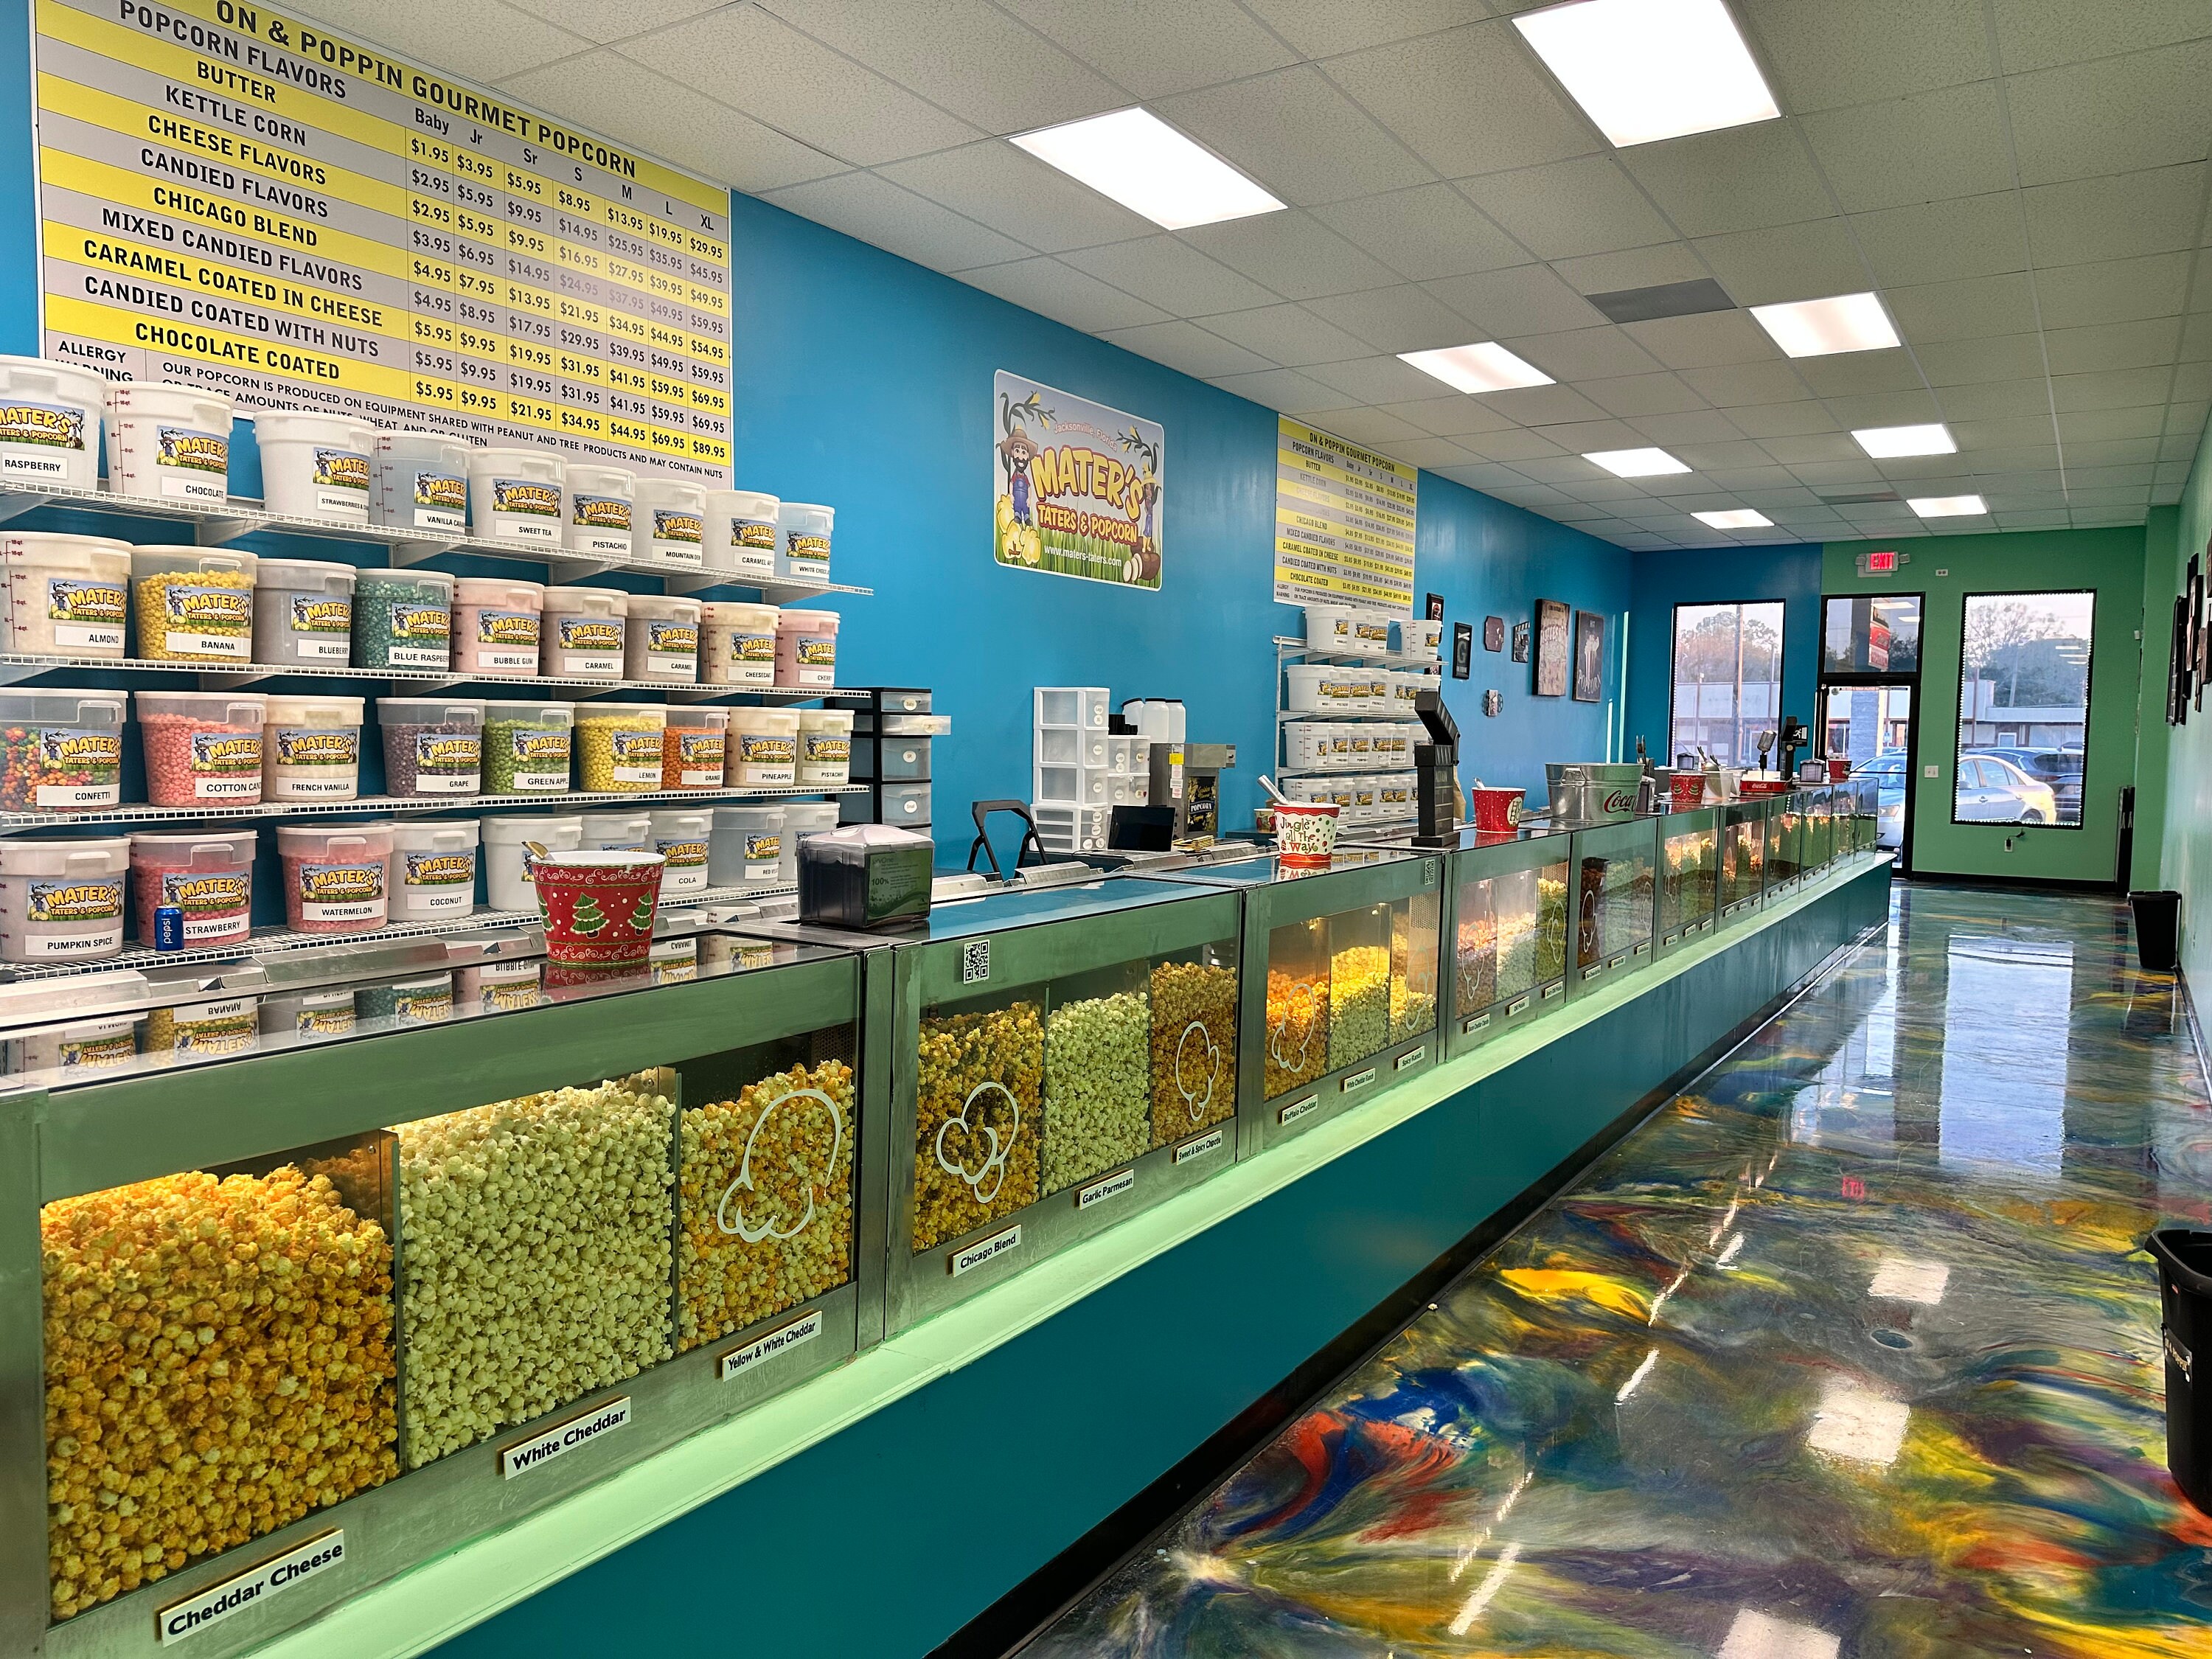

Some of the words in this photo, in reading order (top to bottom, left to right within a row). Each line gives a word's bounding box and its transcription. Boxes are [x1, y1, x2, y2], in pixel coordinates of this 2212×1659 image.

[121, 0, 237, 60] POPCORN
[248, 46, 345, 98] FLAVORS
[198, 60, 276, 103] BUTTER
[218, 0, 256, 33] ON
[268, 21, 289, 46] &
[302, 31, 402, 88] POPPIN
[413, 76, 530, 136] GOURMET
[539, 124, 635, 178] POPCORN
[167, 85, 246, 127] KETTLE
[254, 115, 305, 146] CORN
[149, 116, 233, 156] CHEESE
[240, 143, 325, 184] FLAVORS
[416, 108, 449, 135] Baby
[470, 129, 482, 145] Jr
[524, 148, 538, 164] Sr
[575, 167, 582, 181] S
[622, 184, 631, 200] M
[666, 201, 672, 215] L
[701, 215, 714, 231] XL
[142, 149, 234, 189] CANDIED
[243, 178, 327, 218] FLAVORS
[411, 138, 448, 162] $1.95
[458, 154, 493, 178] $3.95
[508, 172, 540, 195] $5.95
[559, 189, 590, 211] $8.95
[608, 207, 642, 230] $13.95
[650, 222, 681, 244] $19.95
[691, 237, 722, 258] $29.95
[154, 187, 246, 226] CHICAGO
[254, 215, 316, 246] BLEND
[103, 208, 173, 241] MIXED
[183, 230, 271, 266] CANDIED
[280, 254, 361, 290] FLAVORS
[85, 240, 191, 281] CARAMEL
[199, 268, 276, 300] COATED
[283, 288, 303, 307] IN
[311, 296, 382, 327] CHEESE
[86, 276, 182, 313] CANDIED
[192, 301, 268, 332] COATED
[275, 319, 324, 345] WITH
[333, 333, 378, 356] NUTS
[58, 341, 126, 363] ALLERGY
[136, 323, 259, 364] CHOCOLATE
[267, 351, 338, 379] COATED
[163, 362, 192, 376] OUR
[197, 369, 260, 389] POPCORN
[264, 381, 273, 392] IS
[278, 384, 340, 403] PRODUCED
[344, 397, 361, 408] ON
[366, 401, 425, 420] EQUIPMENT
[429, 414, 467, 428] SHARED
[471, 422, 494, 434] WITH
[498, 427, 534, 441] PEANUT
[537, 435, 556, 445] AND
[560, 439, 579, 450] TREE
[584, 444, 626, 459] PRODUCTS
[629, 453, 647, 463] AND
[650, 457, 666, 467] MAY
[669, 461, 702, 474] CONTAIN
[705, 468, 722, 479] NUTS
[417, 380, 453, 401] $5.95
[462, 390, 495, 409] $9.95
[511, 400, 551, 420] $21.95
[562, 411, 599, 431] $34.95
[611, 422, 645, 440] $44.95
[653, 431, 684, 448] $69.95
[693, 440, 724, 458] $89.95
[22, 429, 29, 437] &
[31, 430, 68, 442] POPCORN
[1054, 421, 1095, 438] Jacksonville,
[1096, 429, 1117, 452] Florida
[1293, 442, 1314, 457] POPCORN
[1315, 449, 1335, 464] FLAVORS
[1310, 433, 1317, 442] ON
[1319, 437, 1324, 446] &
[1325, 439, 1345, 453] POPPIN
[1346, 447, 1371, 464] GOURMET
[1372, 456, 1395, 472] POPCORN
[5, 459, 60, 472] RASPBERRY
[1306, 460, 1321, 471] BUTTER
[186, 484, 224, 498] CHOCOLATE
[1030, 446, 1145, 521] MATER'S
[427, 516, 453, 526] VANILLA
[519, 526, 540, 535] SWEET
[1037, 503, 1076, 533] TATERS
[1080, 512, 1088, 532] &
[1091, 515, 1138, 545] POPCORN
[593, 540, 627, 550] PISTACHIO
[1044, 545, 1121, 567] www.maters-taters.com
[1870, 552, 1895, 570] EXIT
[1290, 572, 1312, 583] CHOCOLATE
[1314, 577, 1329, 586] COATED
[182, 594, 247, 614] MATER'S
[88, 634, 119, 644] ALMOND
[201, 641, 235, 650] BANANA
[394, 653, 418, 661] BLUE
[494, 656, 520, 664] BUBBLE
[291, 735, 351, 753] MATER'S
[206, 783, 246, 792] COTTON
[449, 779, 469, 787] GRAPE
[527, 777, 553, 785] GREEN
[75, 790, 110, 801] CONFETTI
[1191, 801, 1212, 812] POPCORN
[1281, 817, 1311, 832] Jingle
[1286, 830, 1295, 841] all
[178, 877, 244, 899] MATER'S
[312, 869, 375, 888] MATER'S
[46, 885, 117, 908] MATER'S
[347, 886, 373, 894] POPCORN
[430, 897, 462, 905] COCONUT
[50, 907, 78, 915] TATERS
[321, 907, 372, 916] WATERMELON
[161, 918, 173, 944] pepsi
[186, 921, 240, 934] STRAWBERRY
[47, 940, 91, 950] PUMPKIN
[94, 937, 113, 947] SPICE
[1284, 1110, 1299, 1121] Buffalo
[1300, 1100, 1316, 1113] Cheddar
[1178, 1150, 1191, 1161] Sweet
[1195, 1144, 1205, 1153] Spicy
[1206, 1135, 1221, 1149] Chipotle
[1082, 1189, 1101, 1203] Garlic
[1102, 1178, 1133, 1196] Parmesan
[961, 1248, 992, 1268] Chicago
[994, 1234, 1015, 1253] Blend
[728, 1352, 753, 1371] Yellow
[755, 1346, 761, 1358] &
[763, 1338, 784, 1354] White
[786, 1322, 815, 1343] Cheddar
[512, 1441, 560, 1470] White
[564, 1410, 625, 1446] Cheddar
[167, 1579, 264, 1635] Cheddar
[271, 1545, 342, 1586] Cheese
